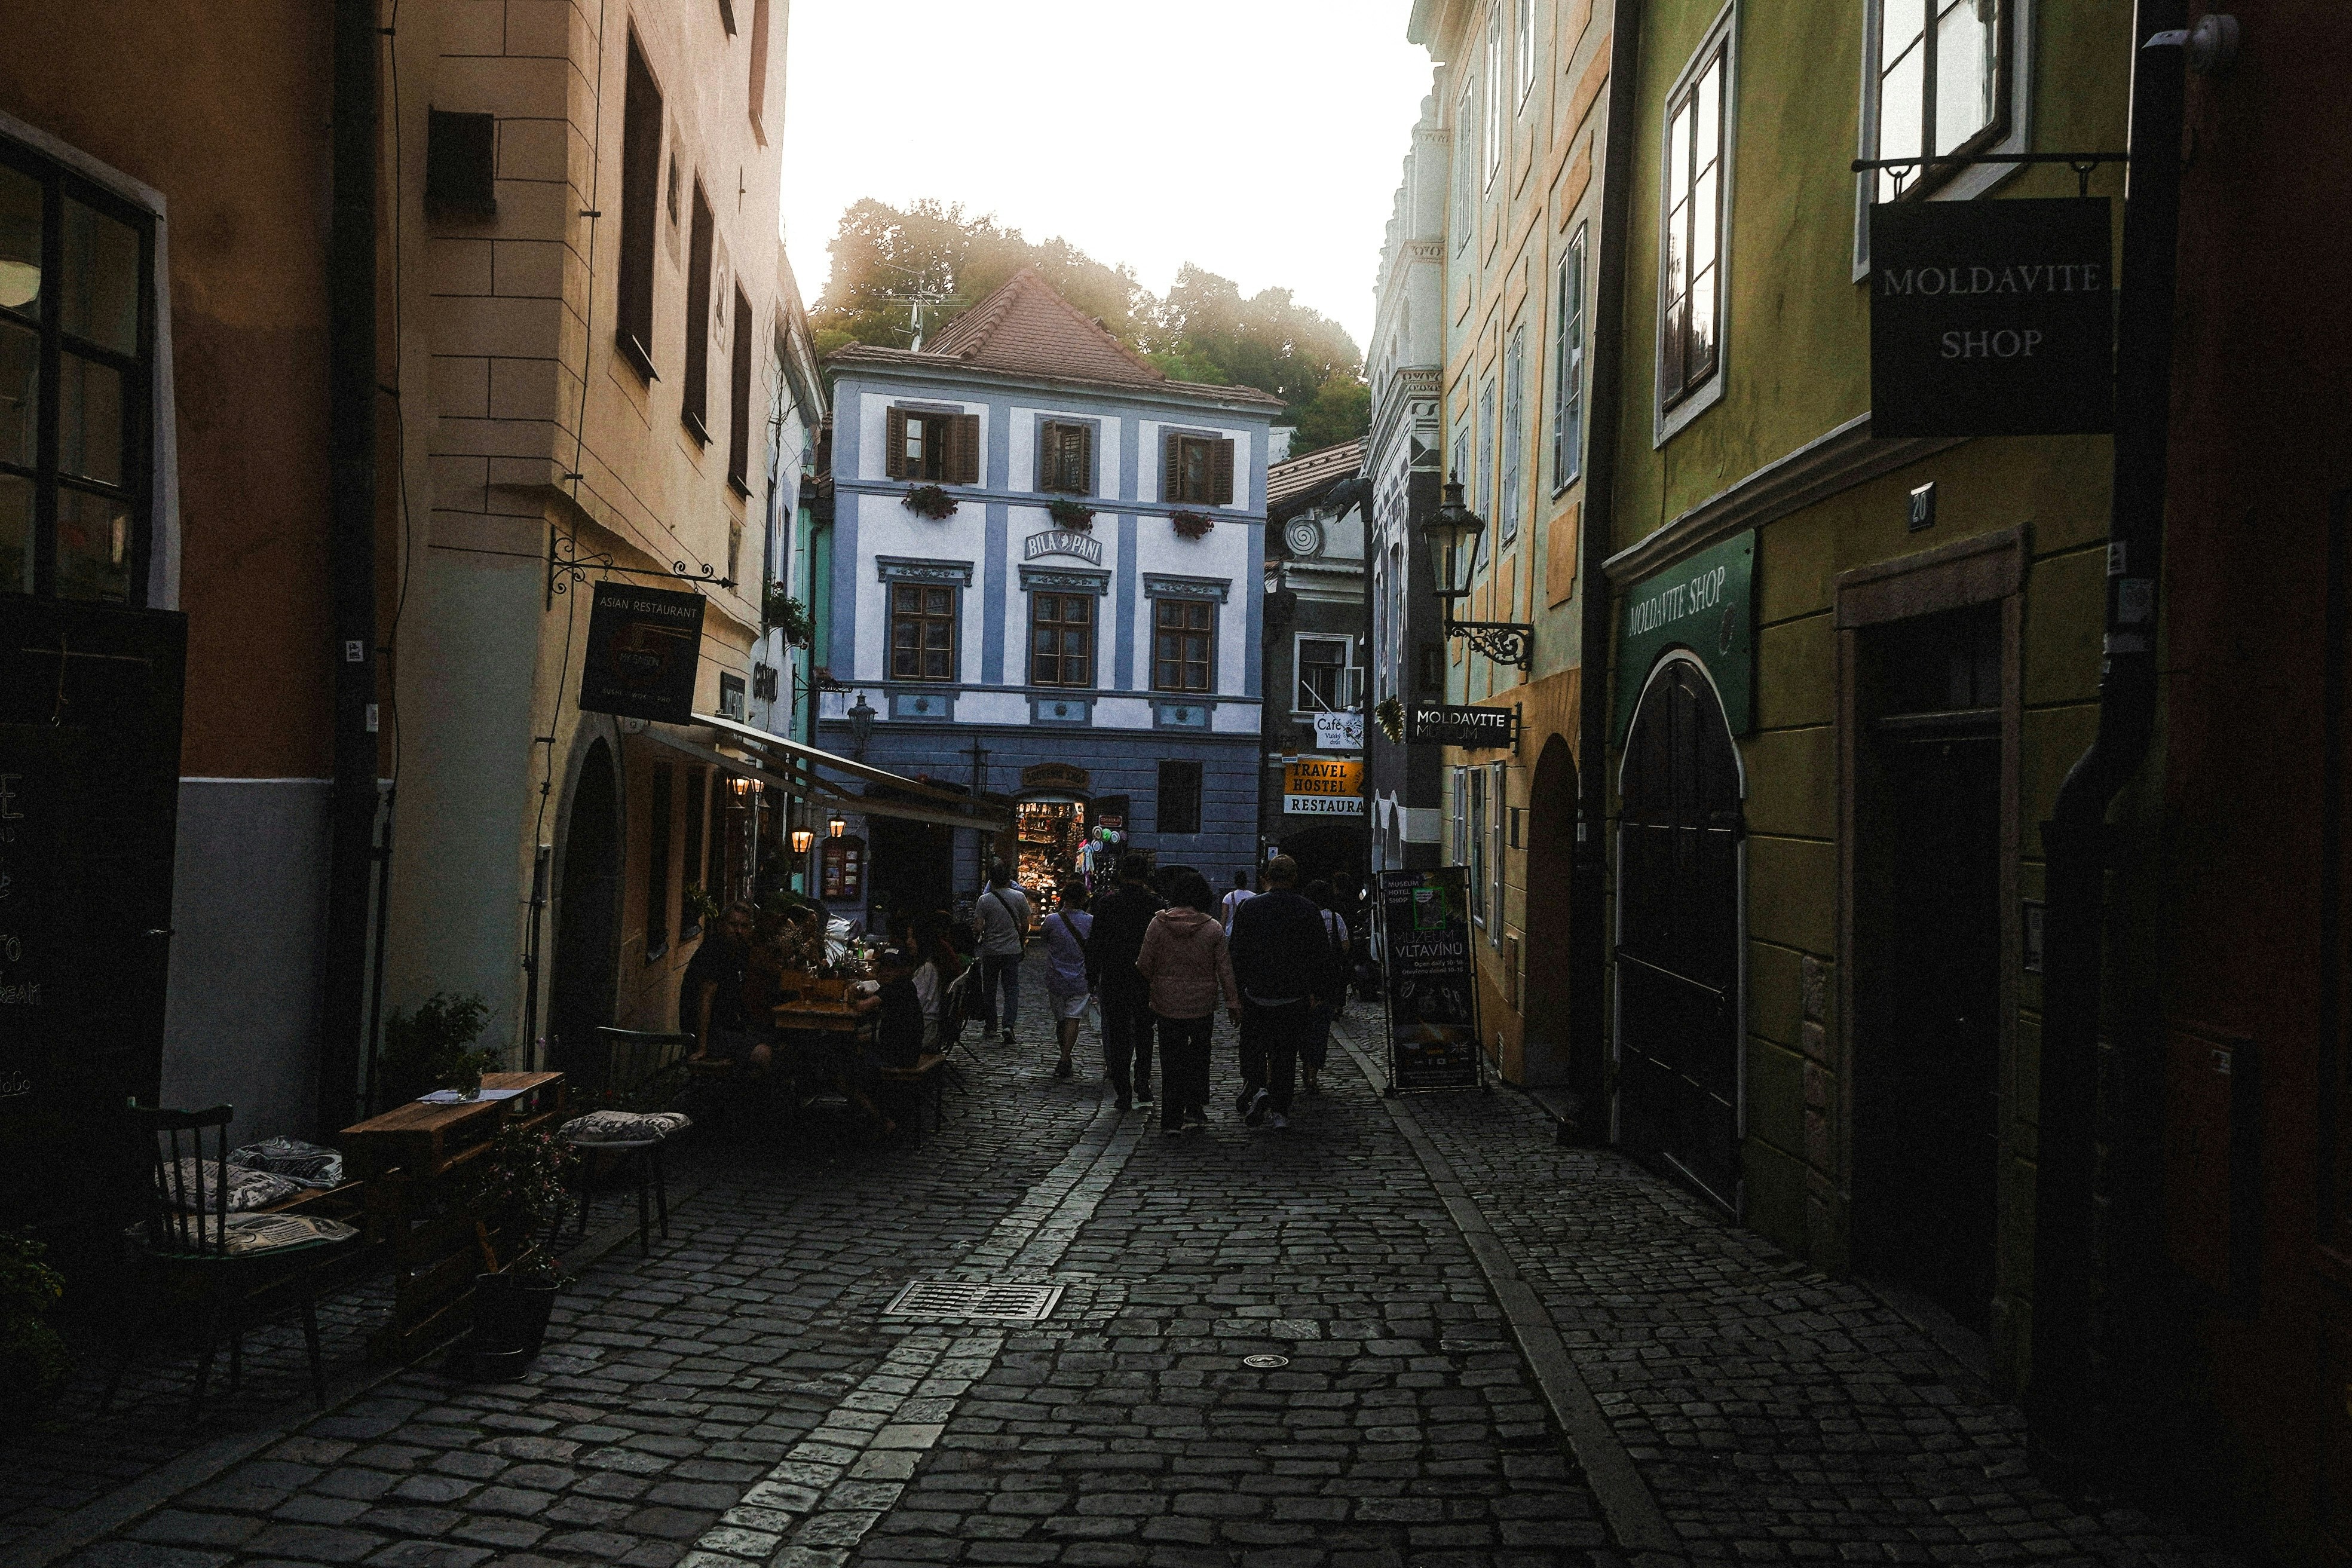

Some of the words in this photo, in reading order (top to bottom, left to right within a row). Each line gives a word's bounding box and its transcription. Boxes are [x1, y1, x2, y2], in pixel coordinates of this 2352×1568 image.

[1884, 264, 2101, 296] MOLDAVITE
[1941, 330, 2042, 358] SHOP
[1913, 492, 1927, 522] 20
[599, 596, 630, 610] ASIAN
[633, 601, 697, 619] RESTAURANT
[1628, 584, 1686, 637] MOLDAVITE
[1689, 565, 1725, 615] SHOP
[1317, 718, 1342, 731] Café
[1417, 710, 1505, 727] MOLDAVITE
[1416, 724, 1478, 740] MUUM
[1293, 763, 1347, 778] TRAVEL
[1293, 779, 1346, 792] HOSTEL
[1291, 799, 1364, 813] RESTAURA
[1394, 930, 1454, 944] MUZEUM
[1395, 942, 1463, 957] VLTAVÍNŮ
